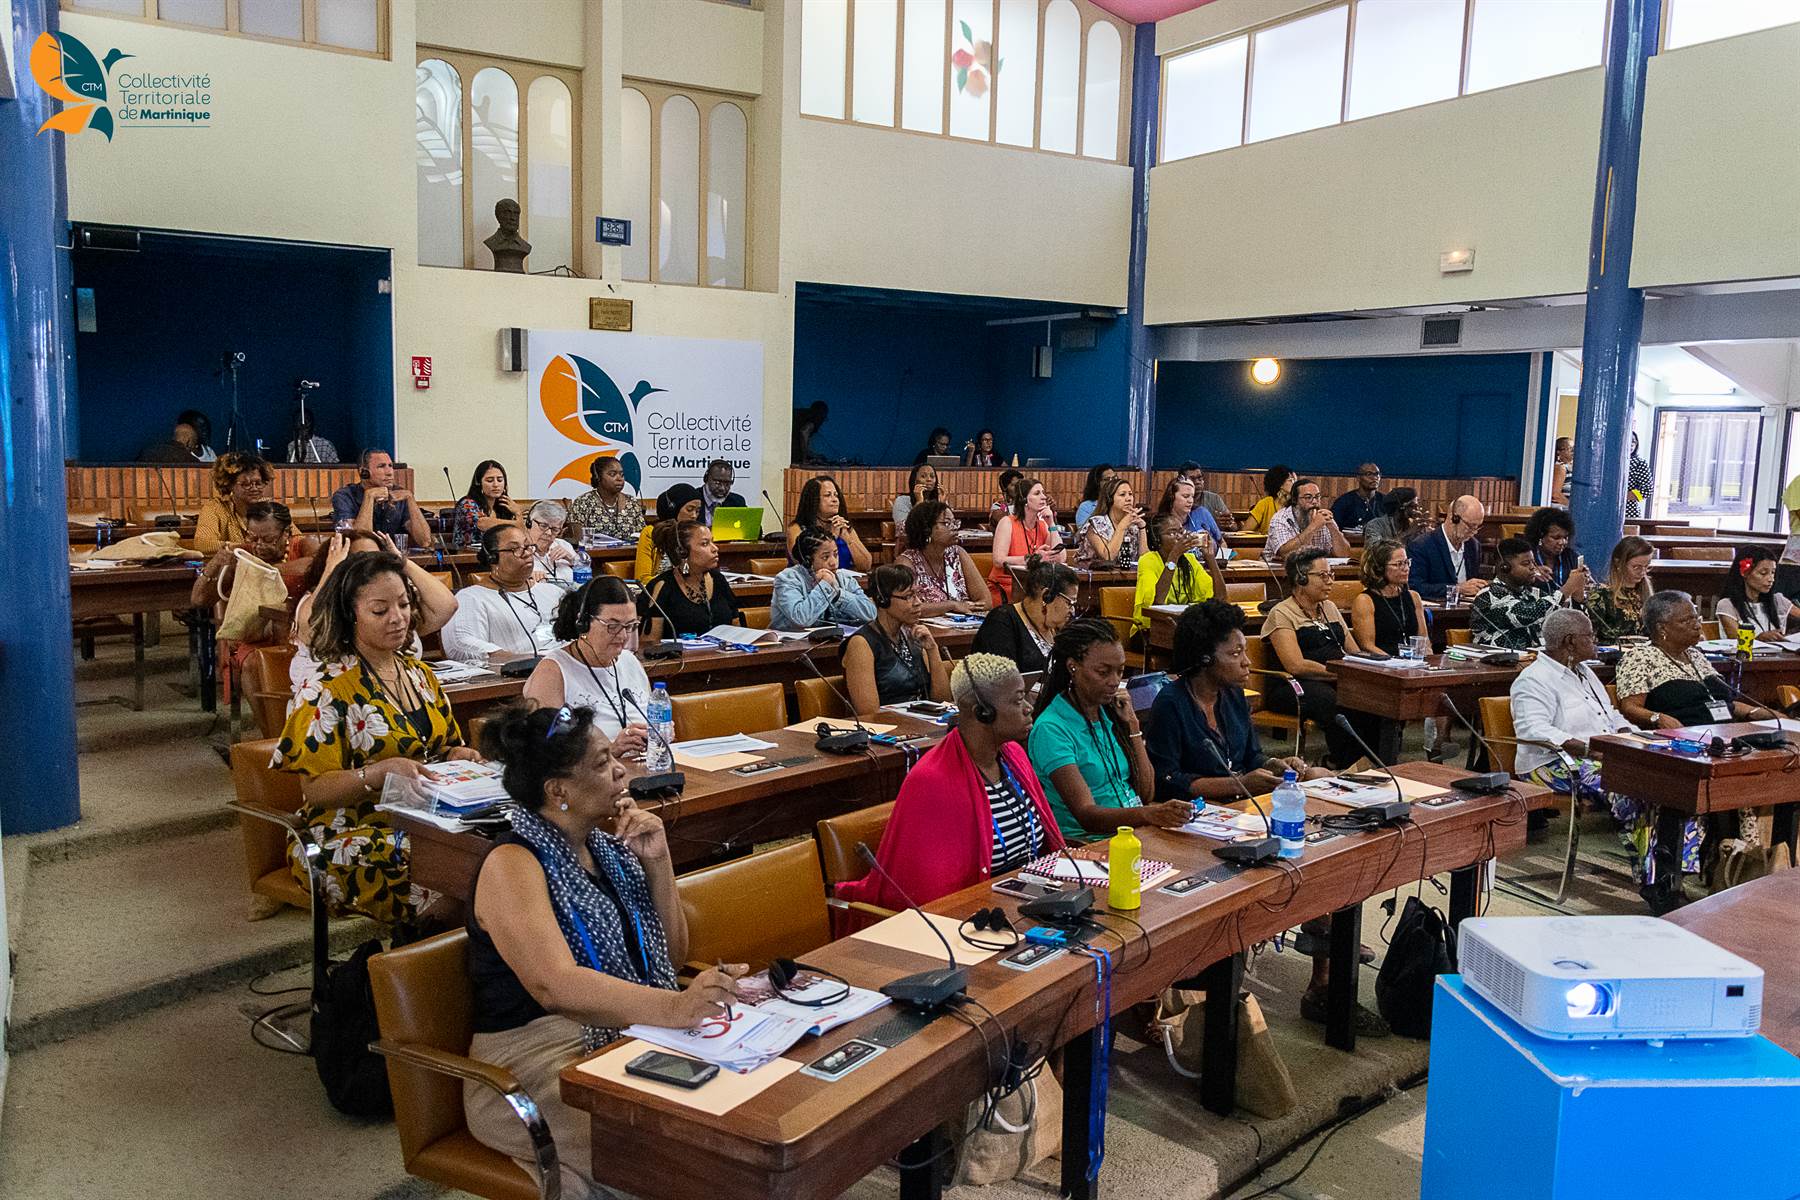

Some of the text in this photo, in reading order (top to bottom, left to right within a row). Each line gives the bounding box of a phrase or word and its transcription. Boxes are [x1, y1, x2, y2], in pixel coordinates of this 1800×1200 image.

[603, 422, 629, 433] CTM
[647, 412, 752, 432] Collectivité
[647, 432, 751, 451] Territoriale
[647, 450, 751, 469] de Martiue
